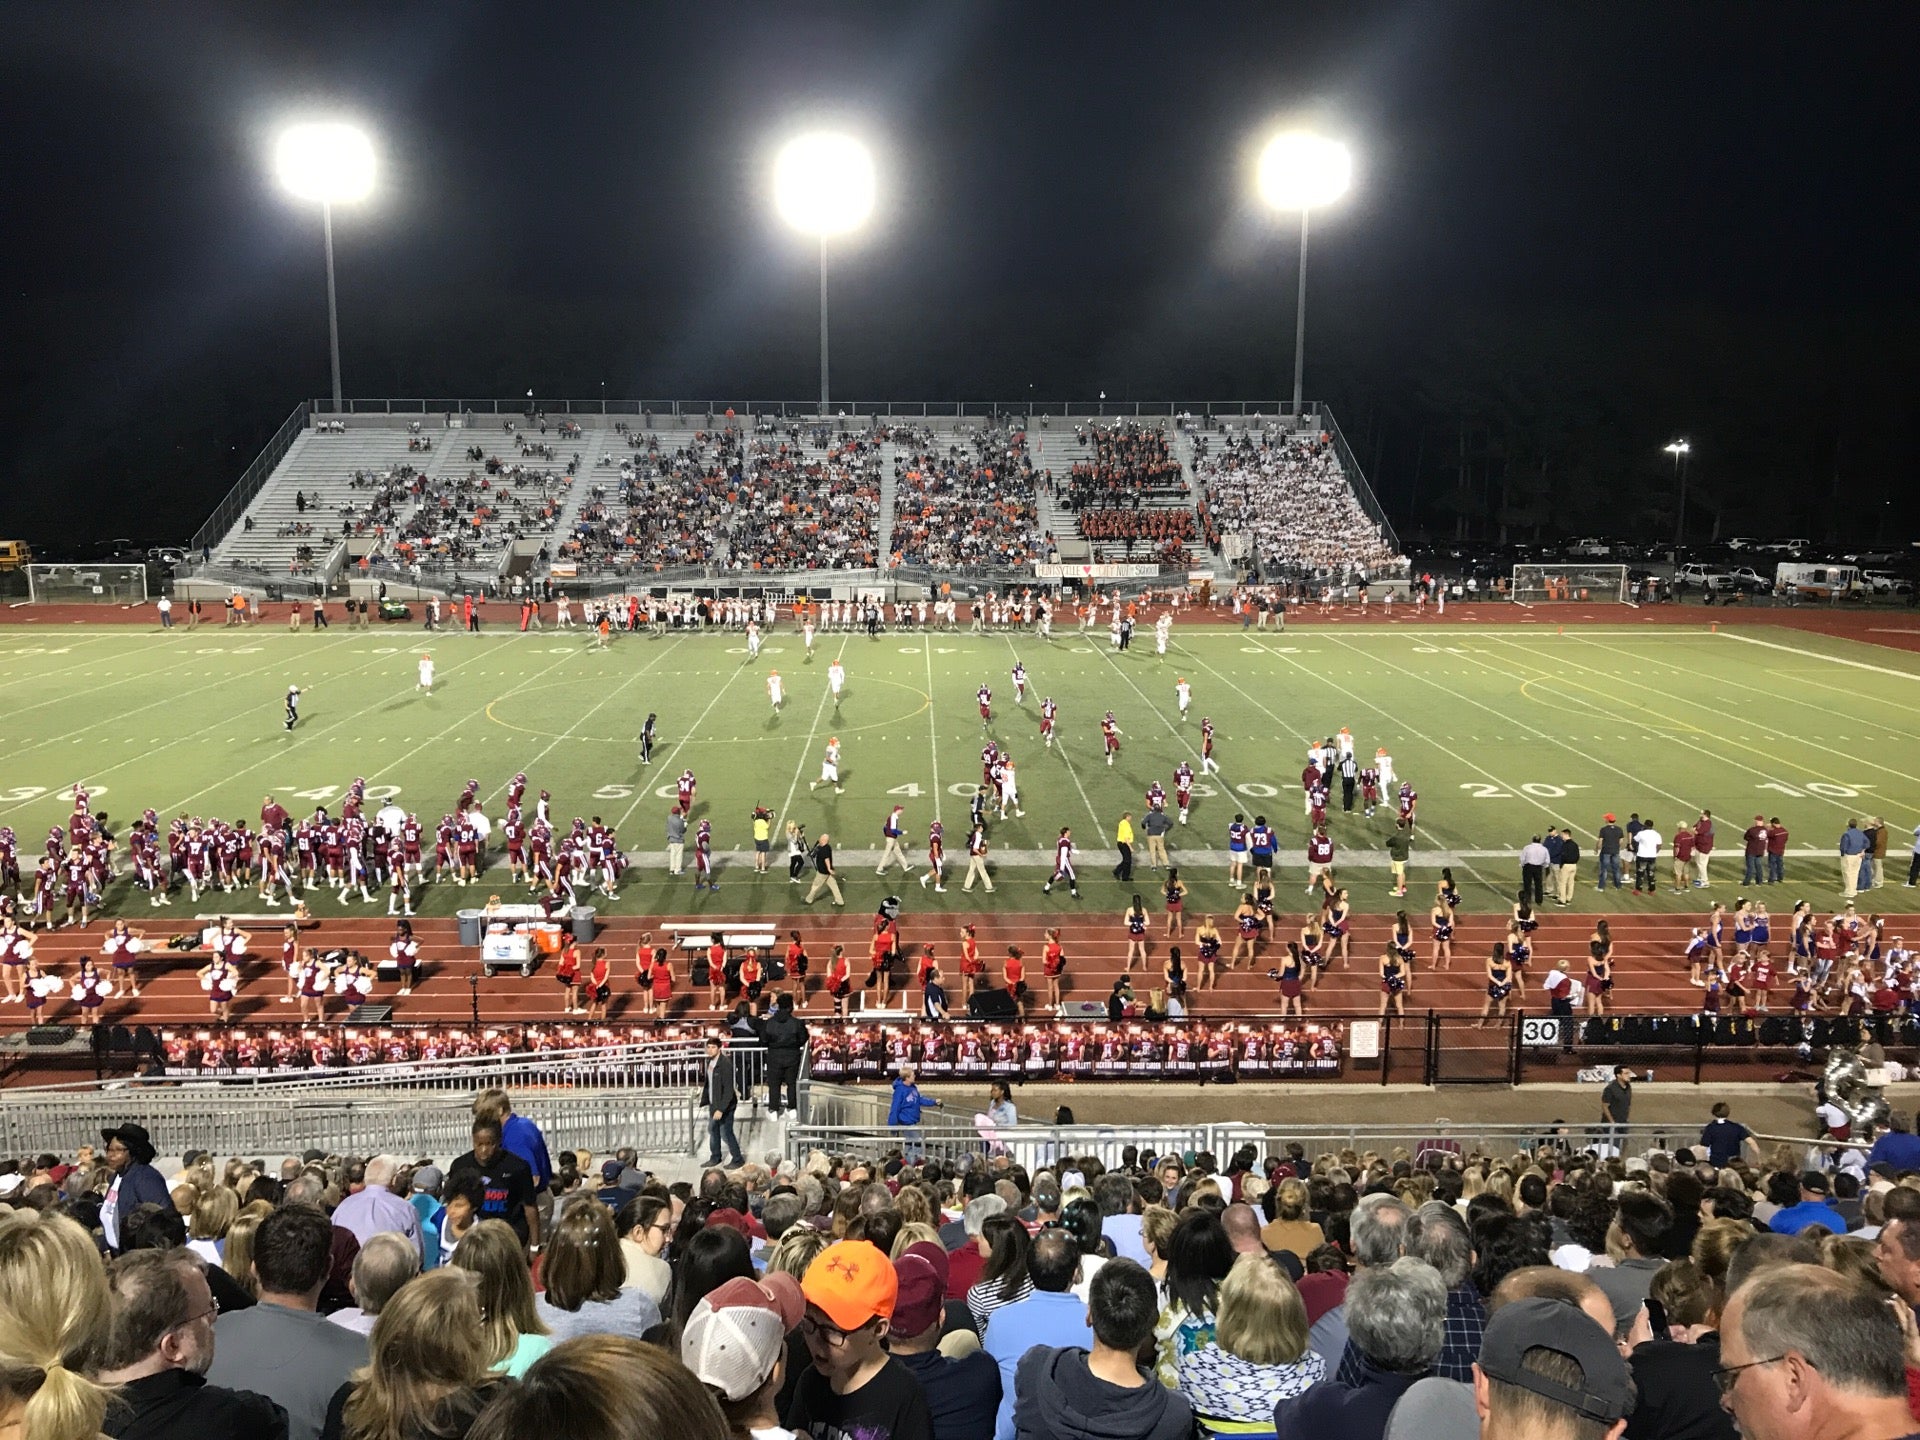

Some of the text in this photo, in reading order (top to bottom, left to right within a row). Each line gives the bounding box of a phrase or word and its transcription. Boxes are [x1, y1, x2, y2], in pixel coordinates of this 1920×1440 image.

[887, 783, 980, 797] 40
[1459, 783, 1567, 798] 20
[405, 829, 416, 841] 16
[1254, 833, 1268, 846] 73
[1318, 843, 1330, 855] 68
[1524, 1021, 1556, 1041] 30
